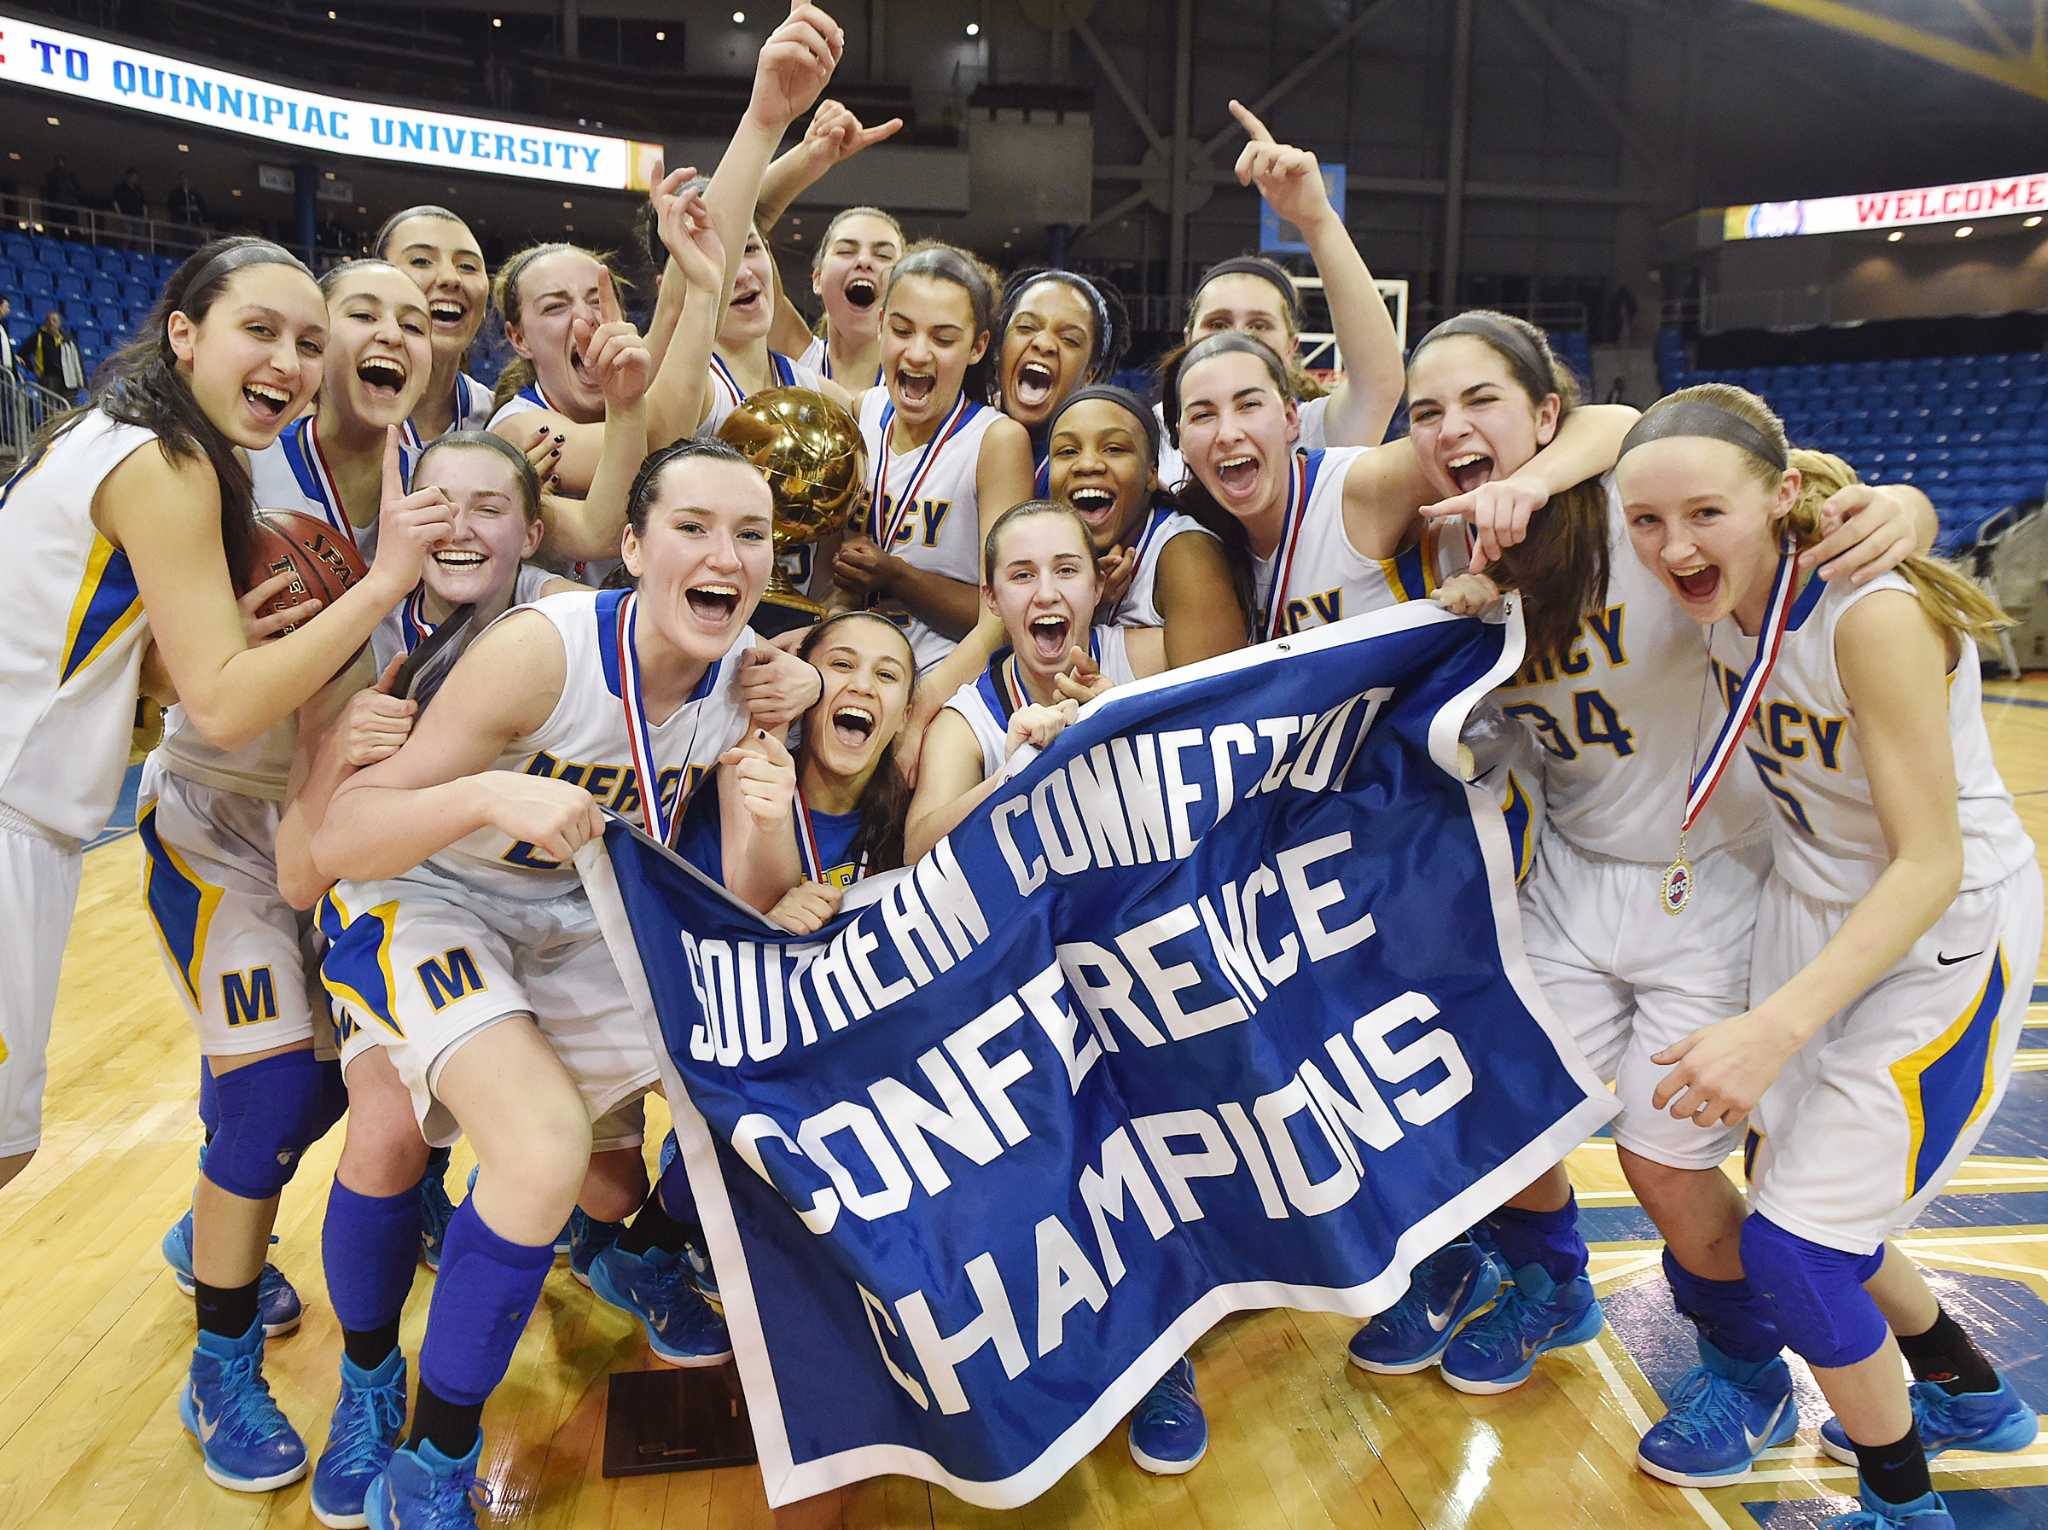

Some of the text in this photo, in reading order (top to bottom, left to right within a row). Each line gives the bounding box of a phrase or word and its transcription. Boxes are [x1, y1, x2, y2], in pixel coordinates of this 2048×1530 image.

[30, 38, 89, 82] TO
[112, 59, 350, 141] QUINNIPIAC
[370, 117, 601, 173] UNIVERSITY
[1856, 179, 2046, 223] WELCOME
[681, 686, 1396, 1067] SOUTHERN CONNECTUT
[220, 964, 280, 1028] M
[415, 945, 488, 1014] M
[731, 830, 1376, 1235] CONFERENCE
[857, 990, 1474, 1416] CHAMPIONS
